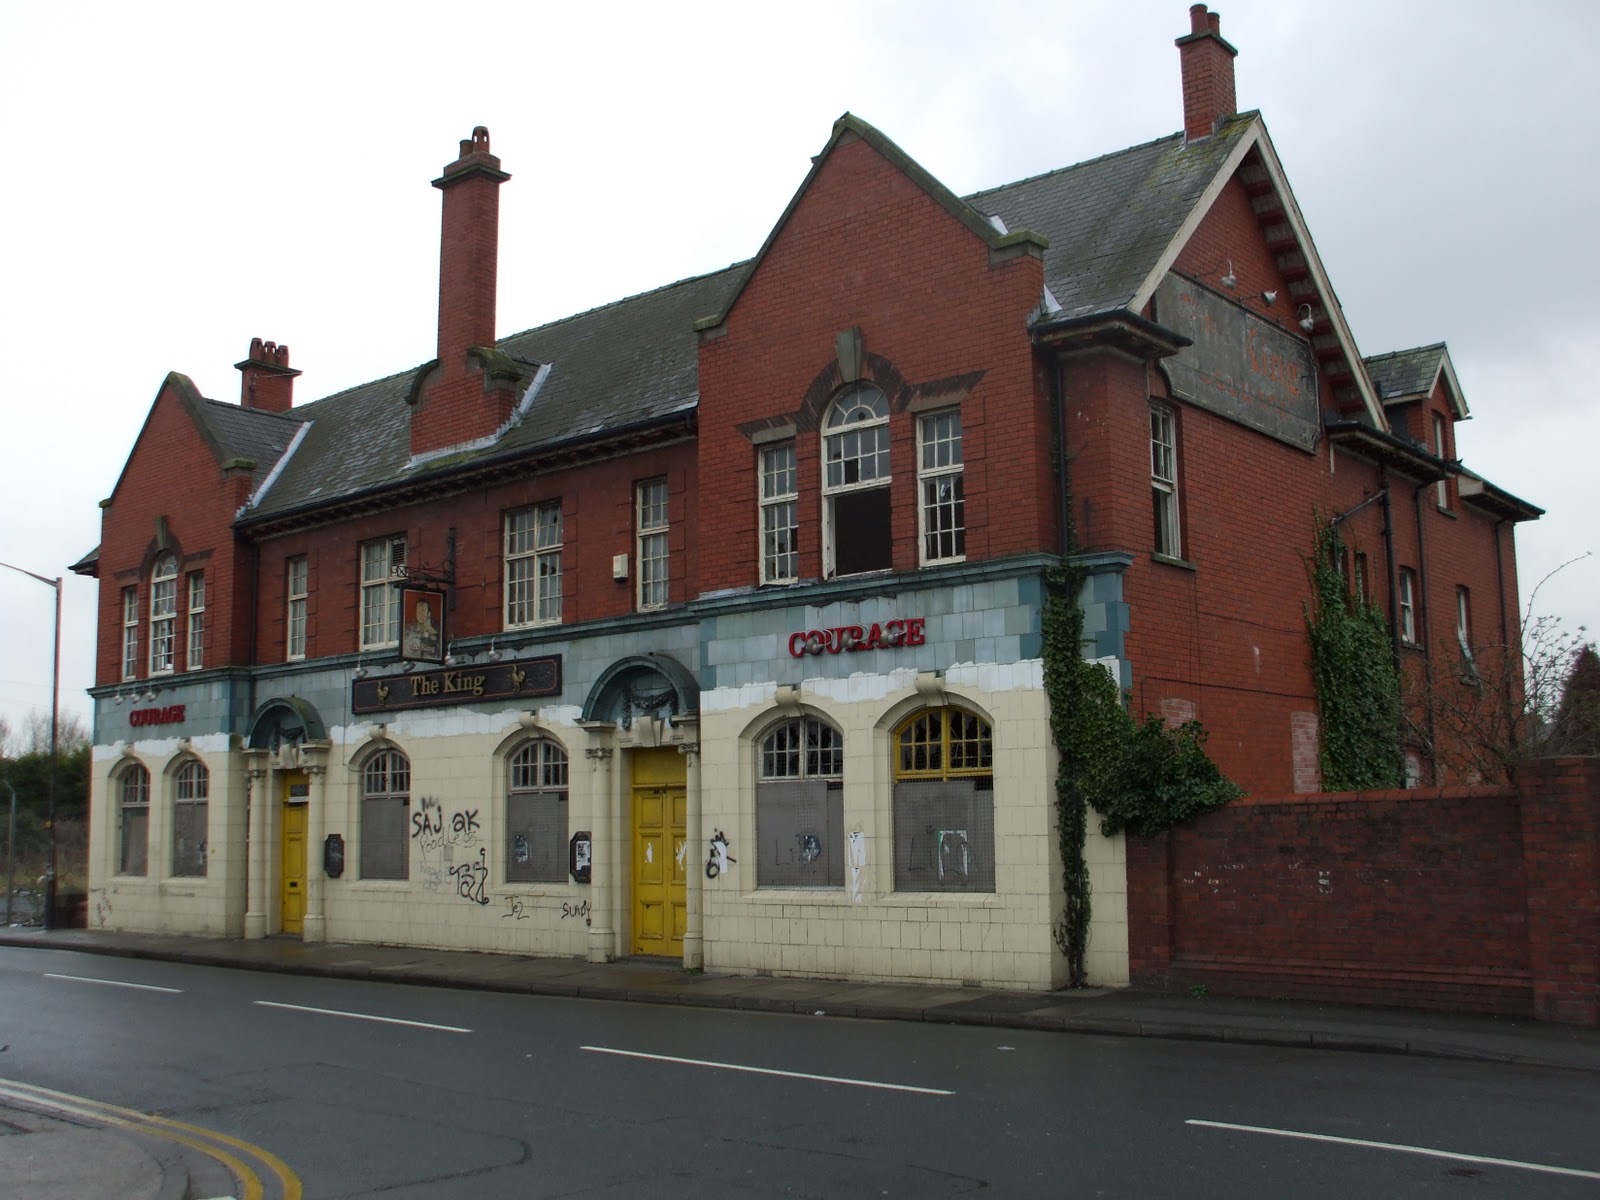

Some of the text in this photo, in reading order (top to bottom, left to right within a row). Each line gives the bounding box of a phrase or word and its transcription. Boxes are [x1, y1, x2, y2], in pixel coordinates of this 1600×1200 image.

[788, 618, 925, 657] COURAGE
[410, 671, 486, 697] The King
[129, 704, 186, 727] COURAGE
